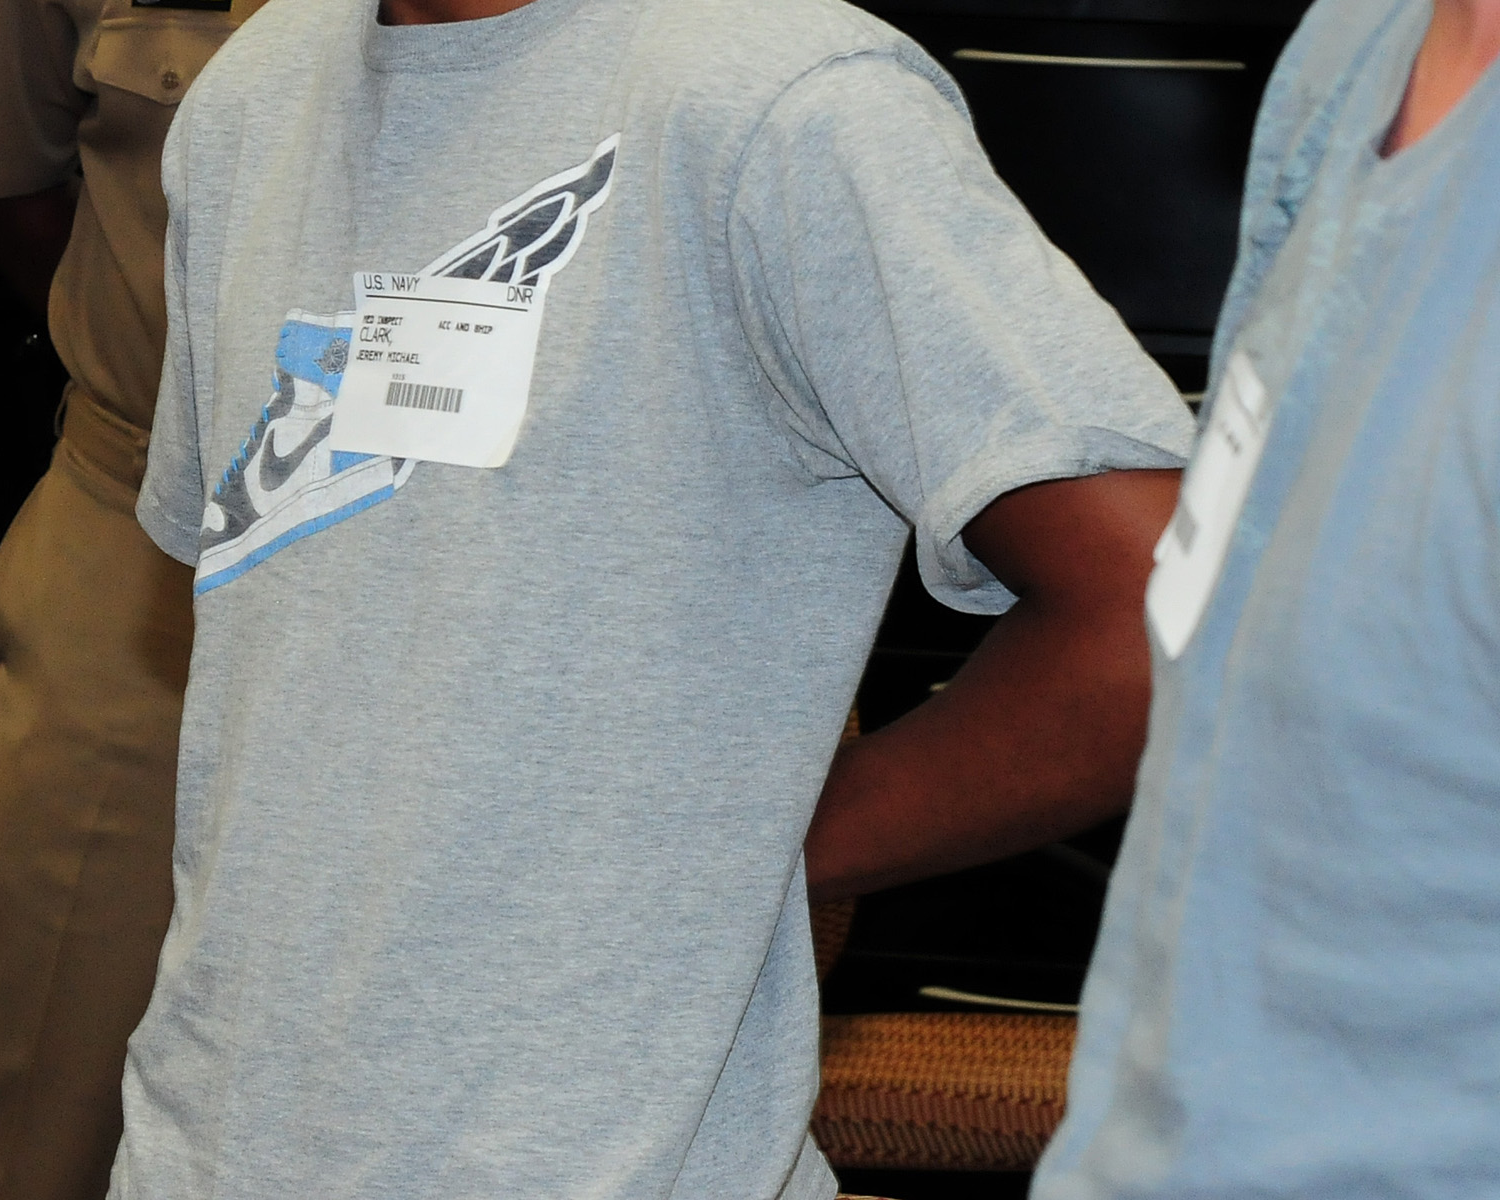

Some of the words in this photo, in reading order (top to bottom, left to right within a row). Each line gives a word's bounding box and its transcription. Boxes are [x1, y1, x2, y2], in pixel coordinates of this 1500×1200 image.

[364, 275, 385, 290] U.S.
[391, 276, 421, 293] NAVY
[507, 287, 533, 304] DNR
[438, 320, 452, 331] ACC
[456, 322, 470, 333] AND
[359, 326, 393, 347] CLARK,
[356, 348, 384, 362] JEREMY
[386, 351, 421, 366] MICHAEL
